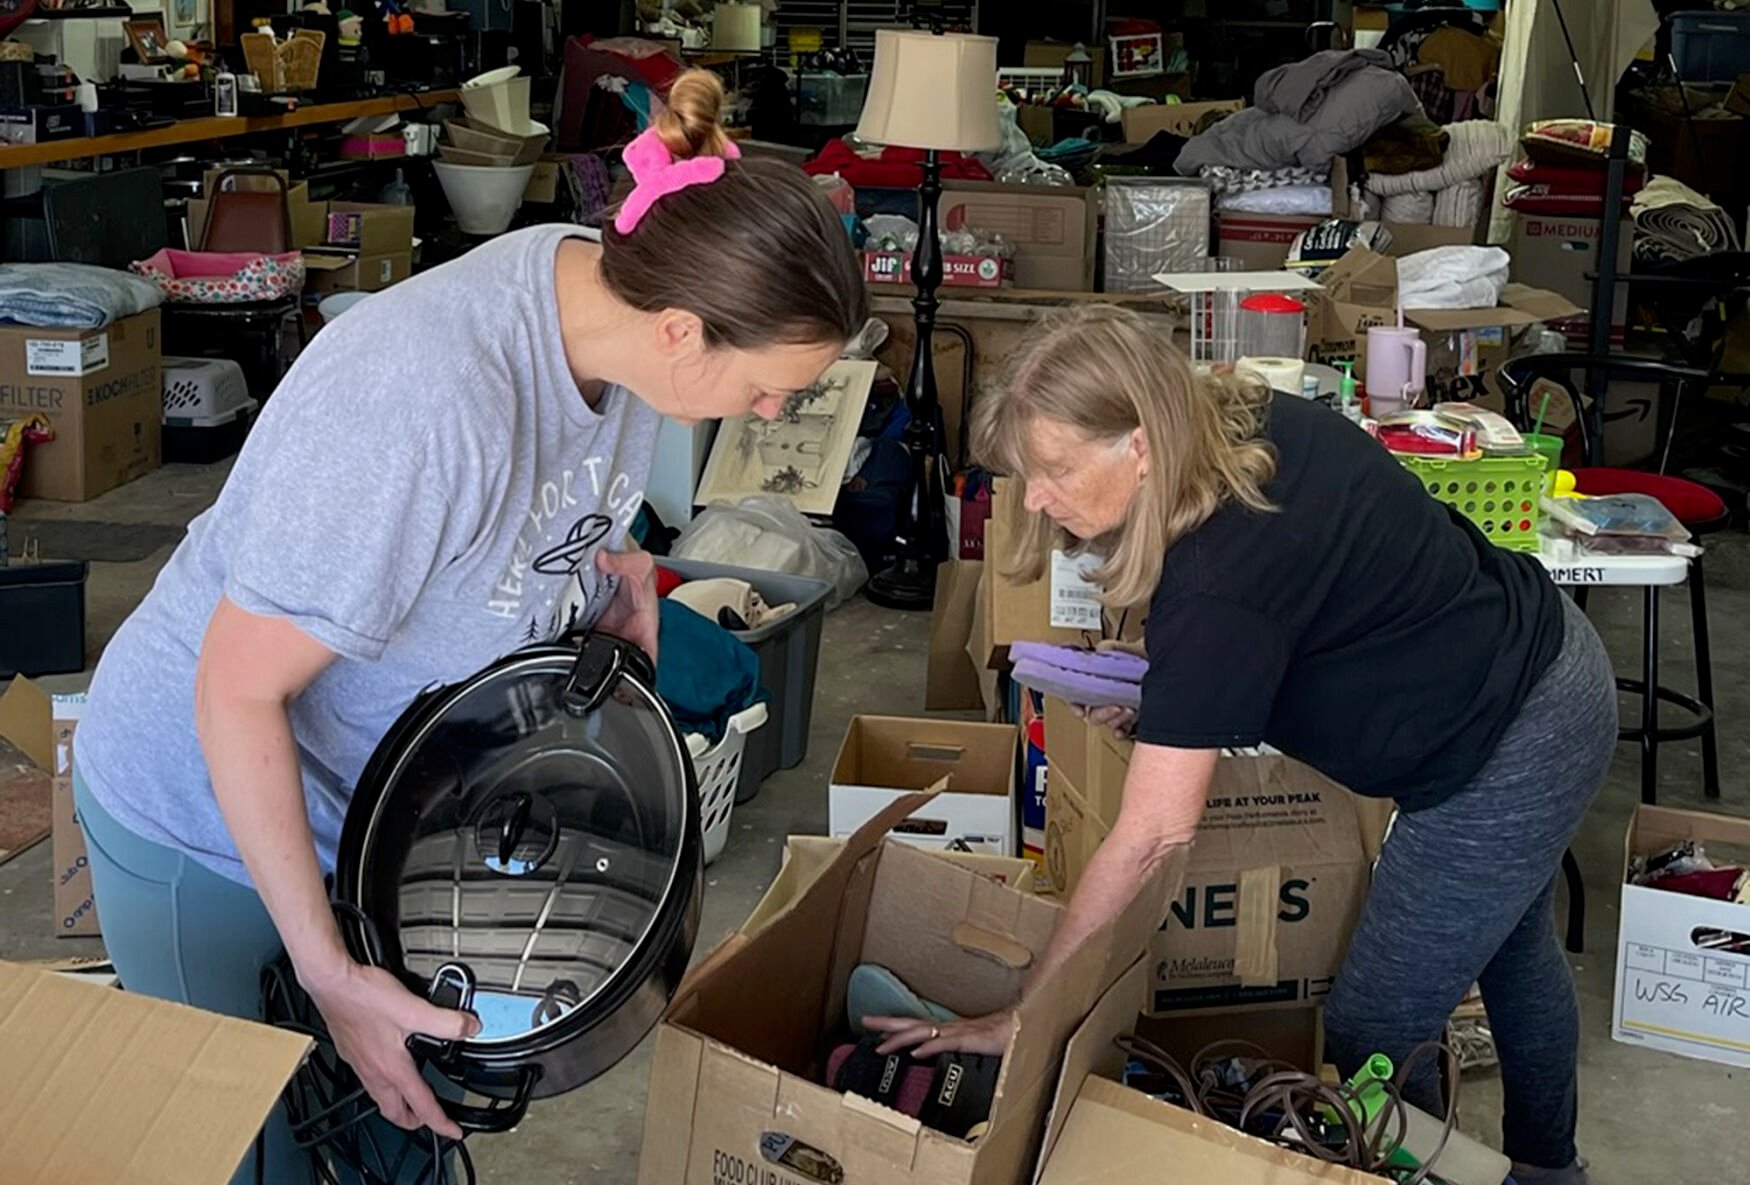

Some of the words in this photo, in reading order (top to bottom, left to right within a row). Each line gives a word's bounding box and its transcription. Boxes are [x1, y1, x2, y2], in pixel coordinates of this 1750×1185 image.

[1543, 223, 1601, 237] MEDIU
[871, 256, 897, 273] Jif
[953, 262, 976, 274] SIZE
[0, 384, 63, 408] FILTER
[1206, 797, 1232, 808] LIFE
[1235, 796, 1249, 807] AT
[1252, 794, 1285, 806] YOUR
[1288, 792, 1321, 804] PEAK
[1158, 879, 1310, 931] NES
[1702, 994, 1750, 1018] AIR
[943, 1067, 959, 1100] ACU
[713, 1149, 745, 1183] FOOD
